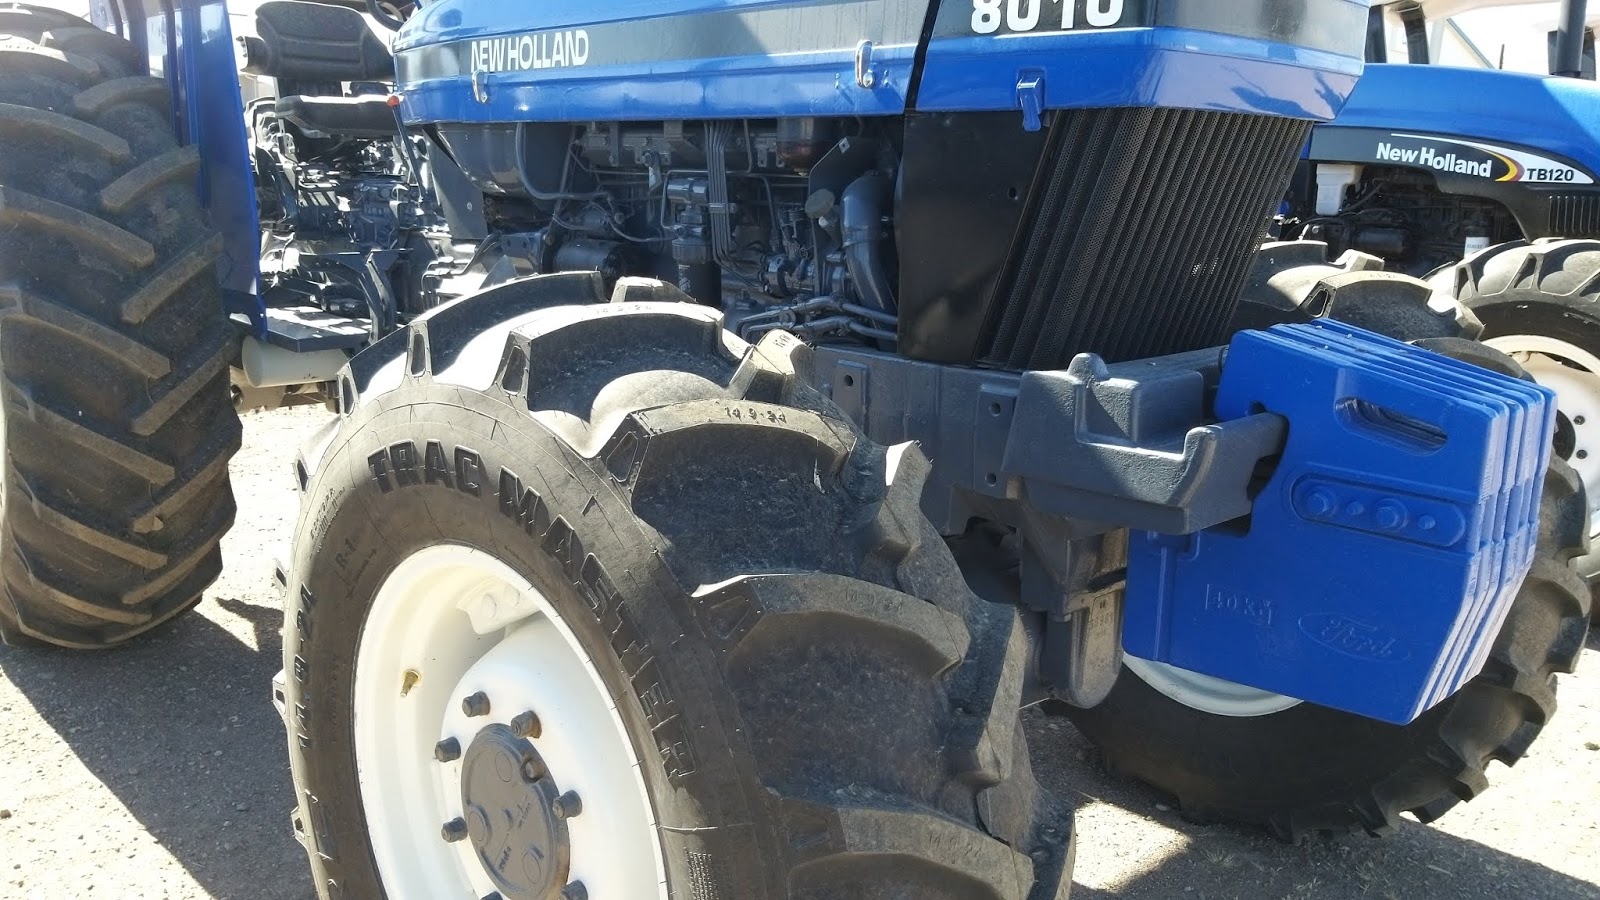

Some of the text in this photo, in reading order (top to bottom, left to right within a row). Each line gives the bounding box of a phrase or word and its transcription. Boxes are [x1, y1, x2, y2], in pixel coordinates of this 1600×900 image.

[970, 0, 1124, 34] 8010
[470, 29, 589, 73] NEW HOLLAND
[1375, 142, 1492, 178] New Holland
[1526, 168, 1575, 182] TB120
[366, 438, 487, 498] TRAC
